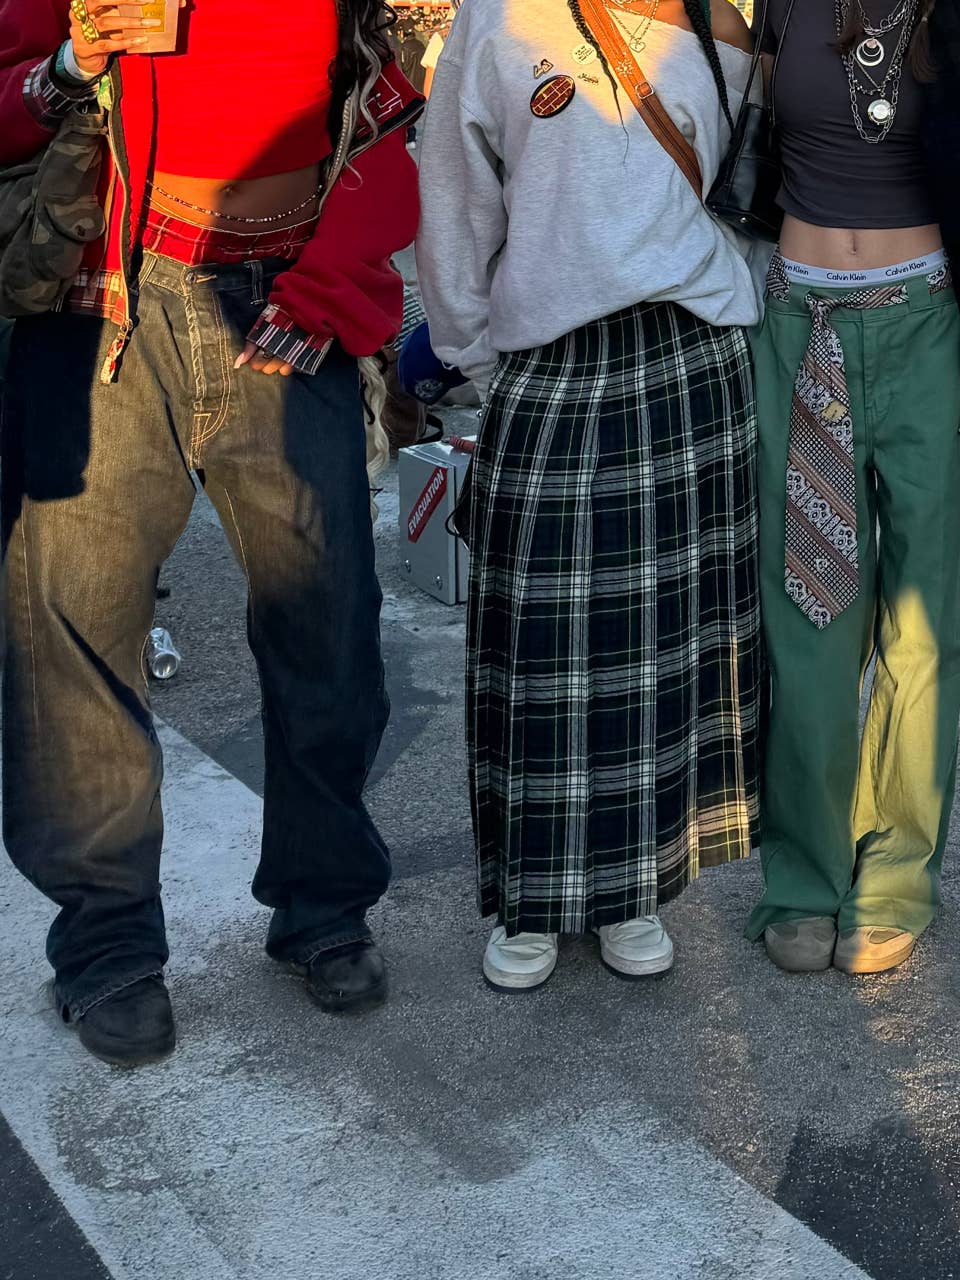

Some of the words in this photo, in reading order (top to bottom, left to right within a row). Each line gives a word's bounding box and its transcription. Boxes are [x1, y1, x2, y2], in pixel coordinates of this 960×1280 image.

[826, 272, 848, 280] Calvin
[850, 273, 867, 281] Klein
[885, 265, 909, 277] Calvin
[908, 260, 927, 271] Klein
[408, 469, 444, 535] EVACUATION
